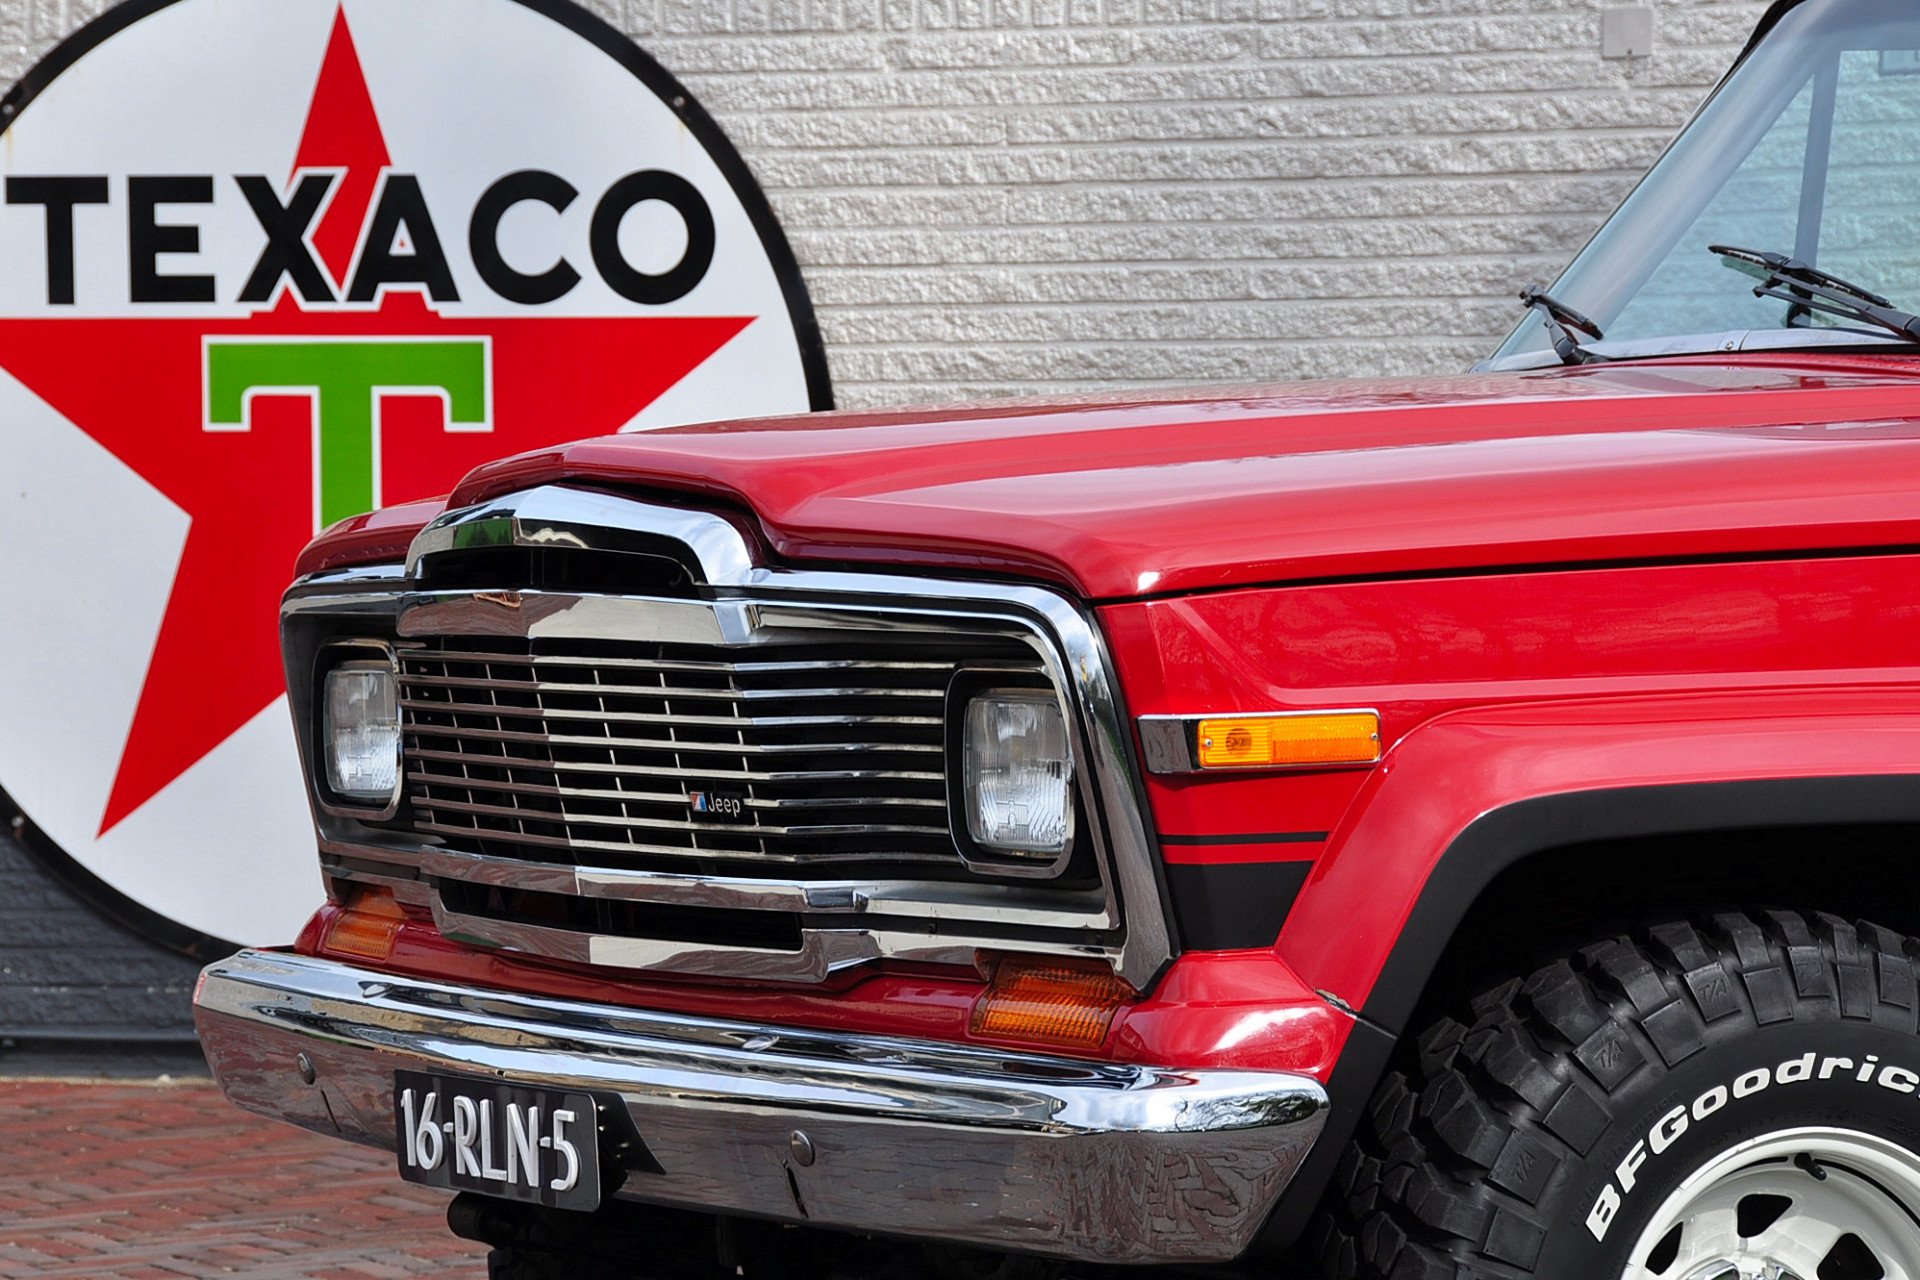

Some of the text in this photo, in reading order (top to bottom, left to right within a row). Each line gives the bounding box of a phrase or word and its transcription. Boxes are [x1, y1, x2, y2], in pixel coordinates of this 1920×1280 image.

[5, 168, 716, 306] TEXACO
[203, 336, 493, 531] T
[709, 793, 741, 818] Jeep
[400, 1088, 579, 1192] 16-RLN-5
[1585, 1052, 1920, 1242] BFGoodric
